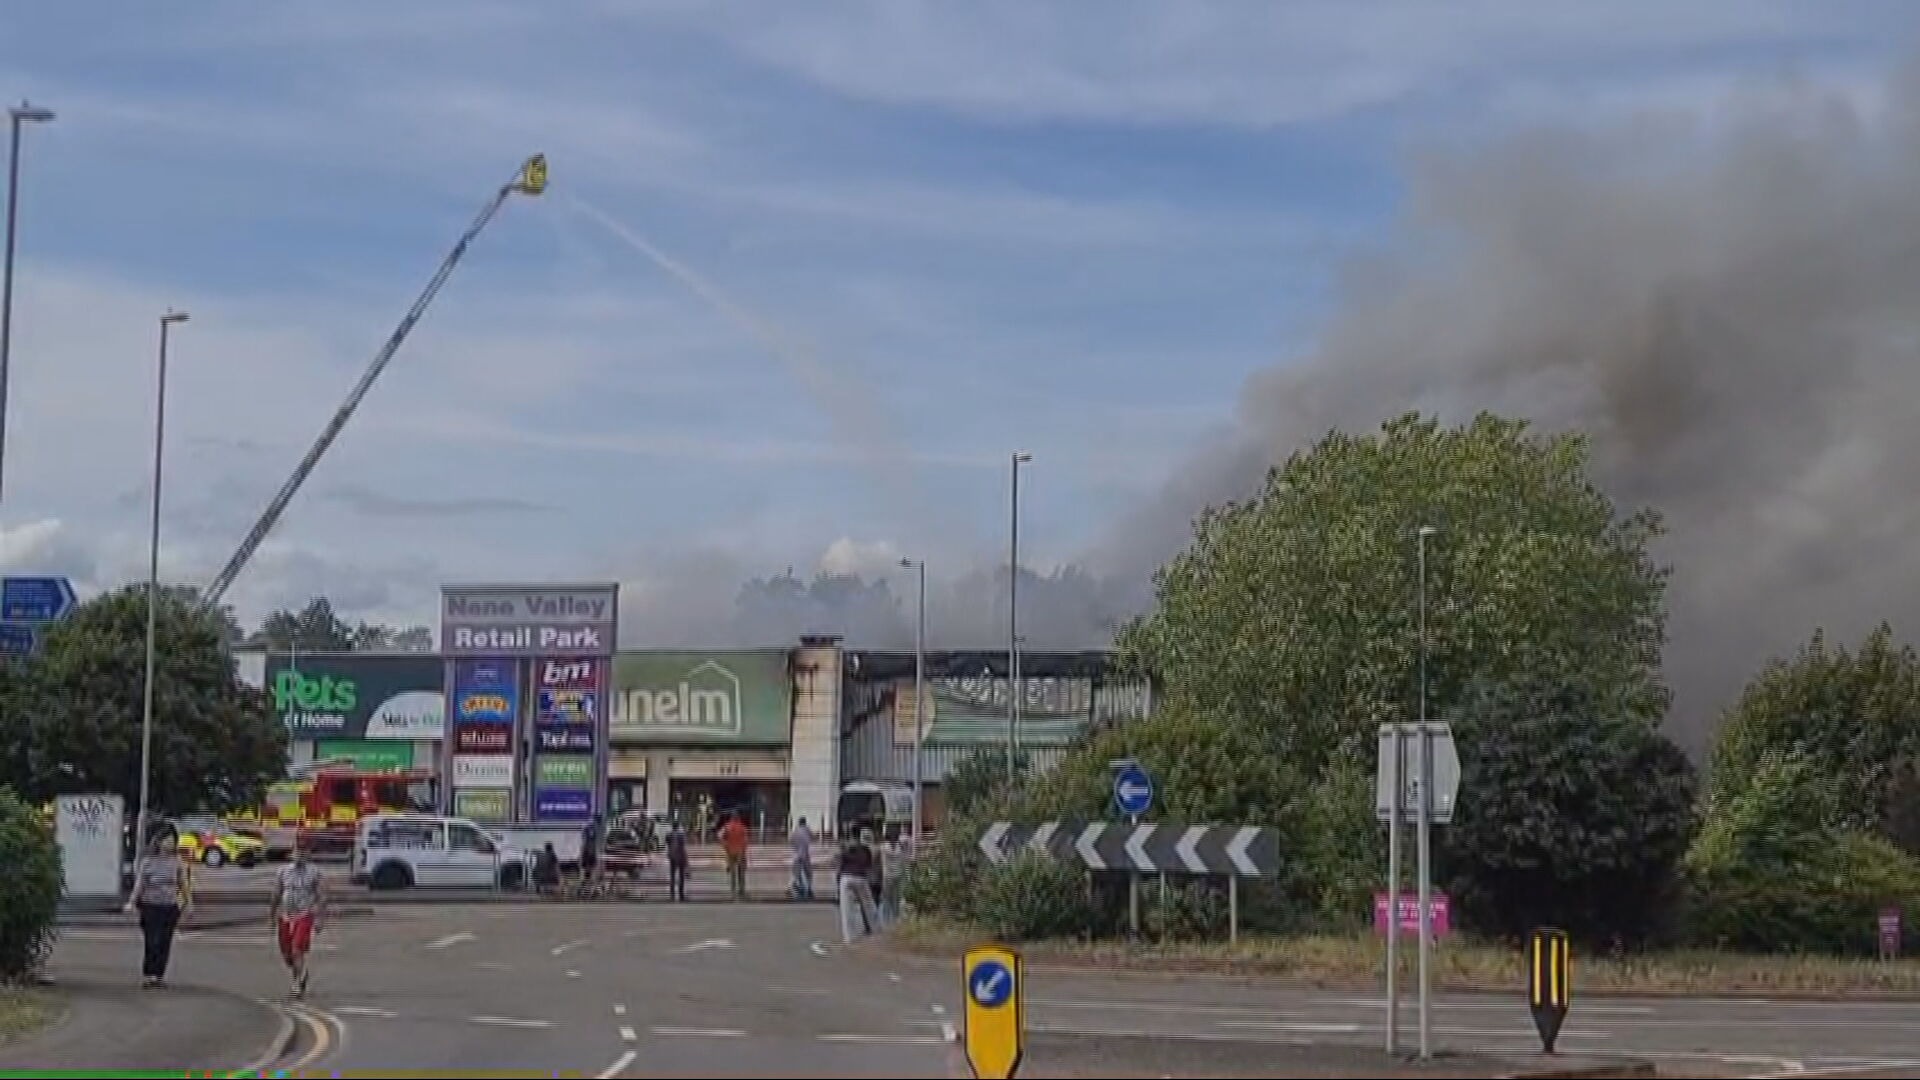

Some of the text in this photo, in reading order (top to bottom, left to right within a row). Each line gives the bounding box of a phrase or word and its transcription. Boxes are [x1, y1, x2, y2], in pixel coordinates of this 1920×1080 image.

[525, 595, 605, 619] Valley
[454, 626, 600, 648] Retail Park
[275, 671, 357, 711] Pets
[609, 681, 731, 723] unelm
[301, 712, 345, 728] Home
